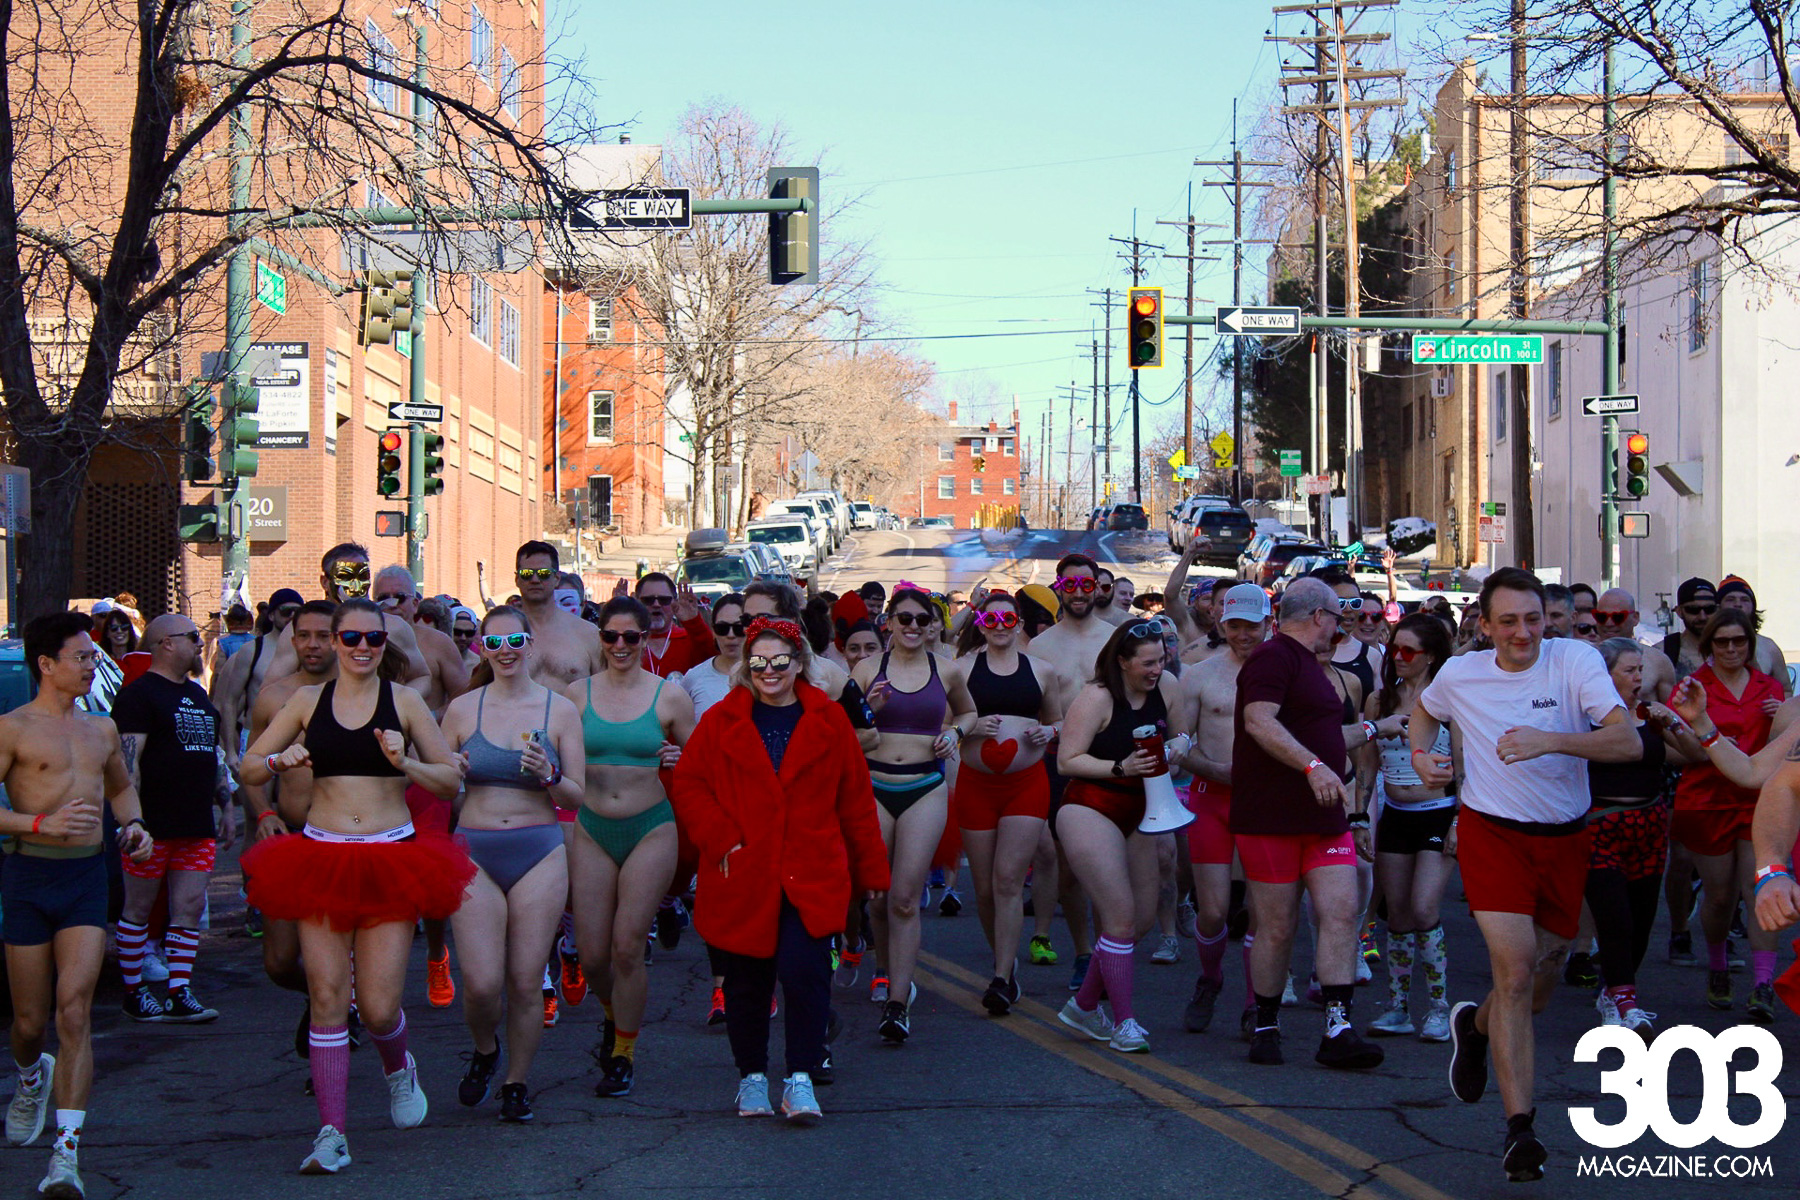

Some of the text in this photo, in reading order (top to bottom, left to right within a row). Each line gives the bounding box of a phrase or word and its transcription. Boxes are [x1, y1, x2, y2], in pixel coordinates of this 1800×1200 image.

[606, 200, 677, 216] ONE WAY
[1242, 315, 1290, 326] ONE WAY
[268, 345, 303, 354] LEASE
[1441, 339, 1511, 359] Lincoln
[1516, 350, 1537, 359] 100 E
[404, 408, 419, 416] ONE
[249, 497, 274, 515] 20
[255, 519, 282, 527] Street
[1532, 698, 1558, 709] Modelo
